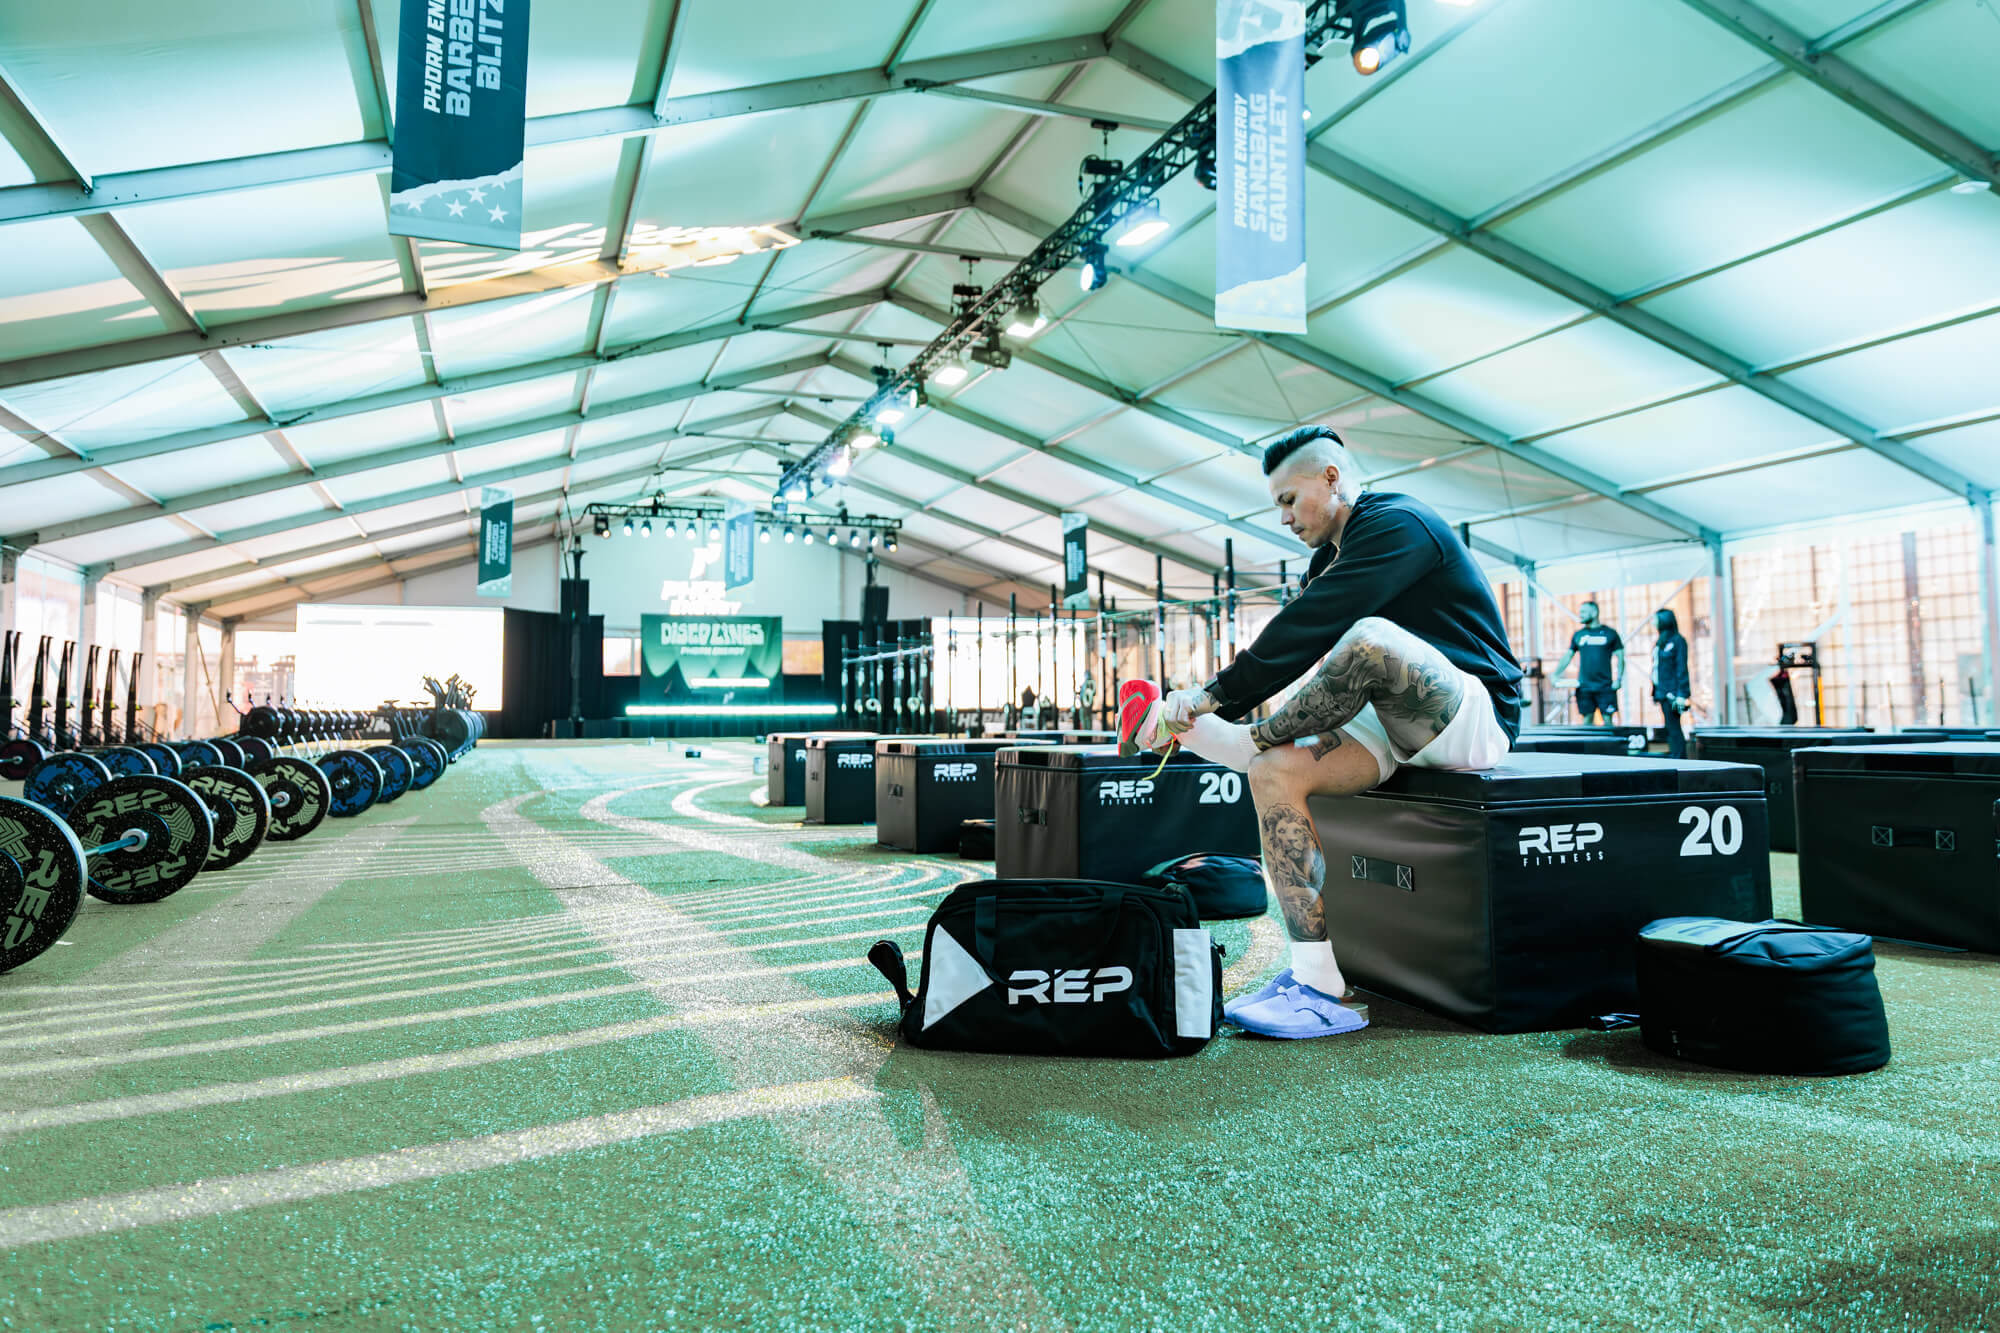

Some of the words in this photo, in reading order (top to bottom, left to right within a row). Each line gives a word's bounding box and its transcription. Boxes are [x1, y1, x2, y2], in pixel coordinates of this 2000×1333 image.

[427, 0, 446, 32] EN
[424, 33, 444, 113] PHORM
[1234, 92, 1248, 163] ENERGY
[1249, 93, 1268, 232] SANDBAG
[1269, 88, 1288, 242] GAUNTLET
[1234, 165, 1248, 229] PHORM
[838, 753, 874, 765] REP
[934, 763, 978, 778] REP
[189, 776, 253, 803] REP
[275, 765, 320, 795] REP
[1100, 780, 1155, 799] REP
[1199, 771, 1243, 804] 20
[86, 788, 169, 824] REP
[1518, 822, 1604, 855] REP
[1678, 805, 1743, 857] 20
[104, 855, 187, 891] REP
[1523, 851, 1604, 868] FITNESS
[4, 849, 61, 950] REP
[1008, 966, 1134, 1005] REP
